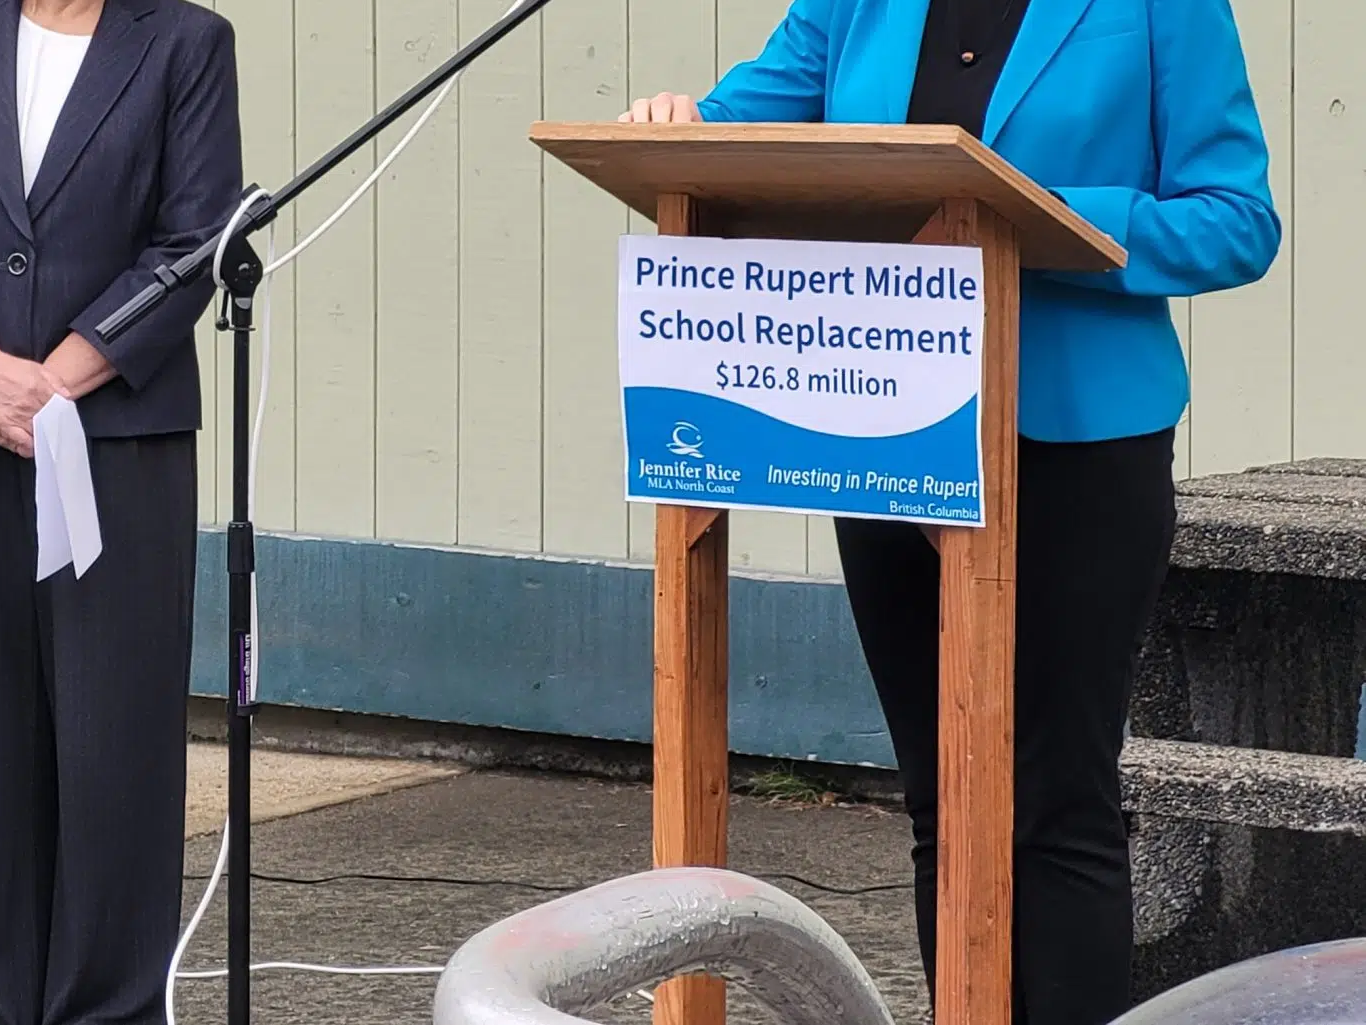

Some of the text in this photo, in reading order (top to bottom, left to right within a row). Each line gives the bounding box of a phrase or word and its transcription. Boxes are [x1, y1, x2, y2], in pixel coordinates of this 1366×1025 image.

[636, 256, 977, 301] Prince Rupert Middle
[638, 309, 972, 355] School Replacement
[715, 360, 898, 397] $126.8 million
[638, 458, 741, 482] Jennifer Rice
[647, 477, 735, 494] MLA North Coast
[767, 464, 978, 501] Investing in Prince Rupert
[889, 500, 979, 520] British Columbia
